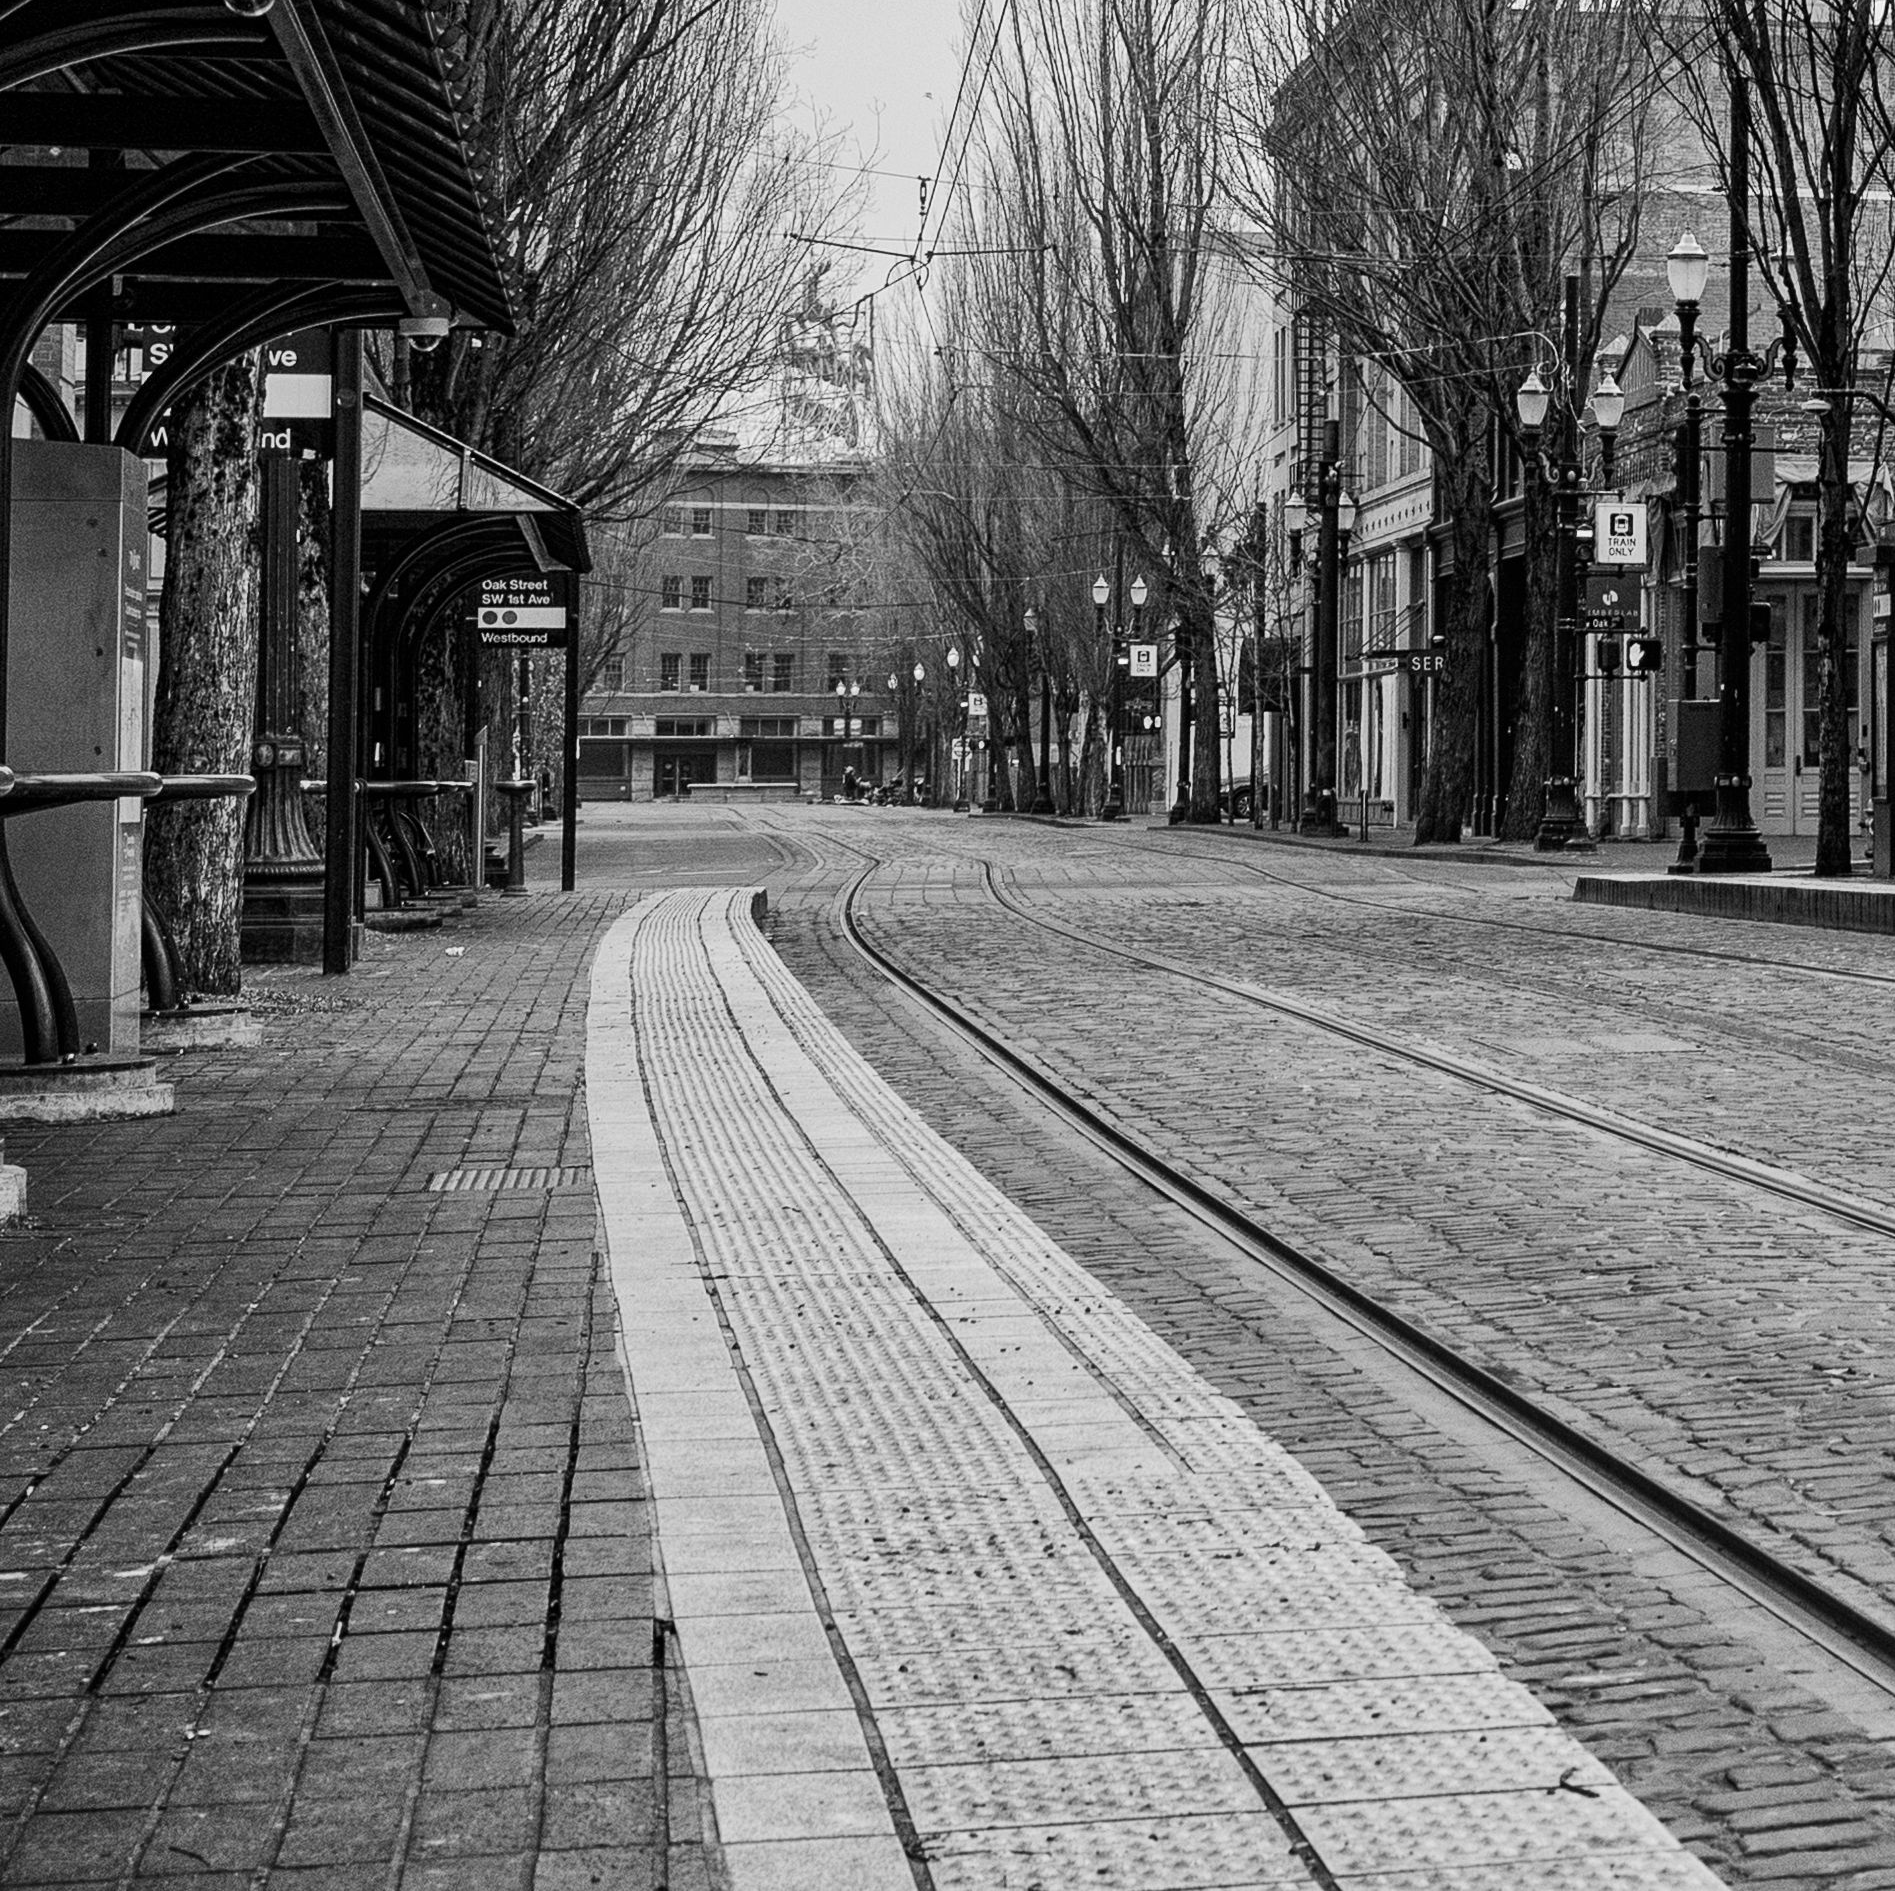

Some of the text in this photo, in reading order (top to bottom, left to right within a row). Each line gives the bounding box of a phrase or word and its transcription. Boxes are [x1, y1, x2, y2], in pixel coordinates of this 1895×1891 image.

[1608, 537, 1636, 547] TRAIN
[1608, 547, 1634, 557] ONLY
[482, 579, 548, 590] Oak Street
[482, 594, 551, 605] SW 1st Ave
[481, 632, 548, 643] Westbound
